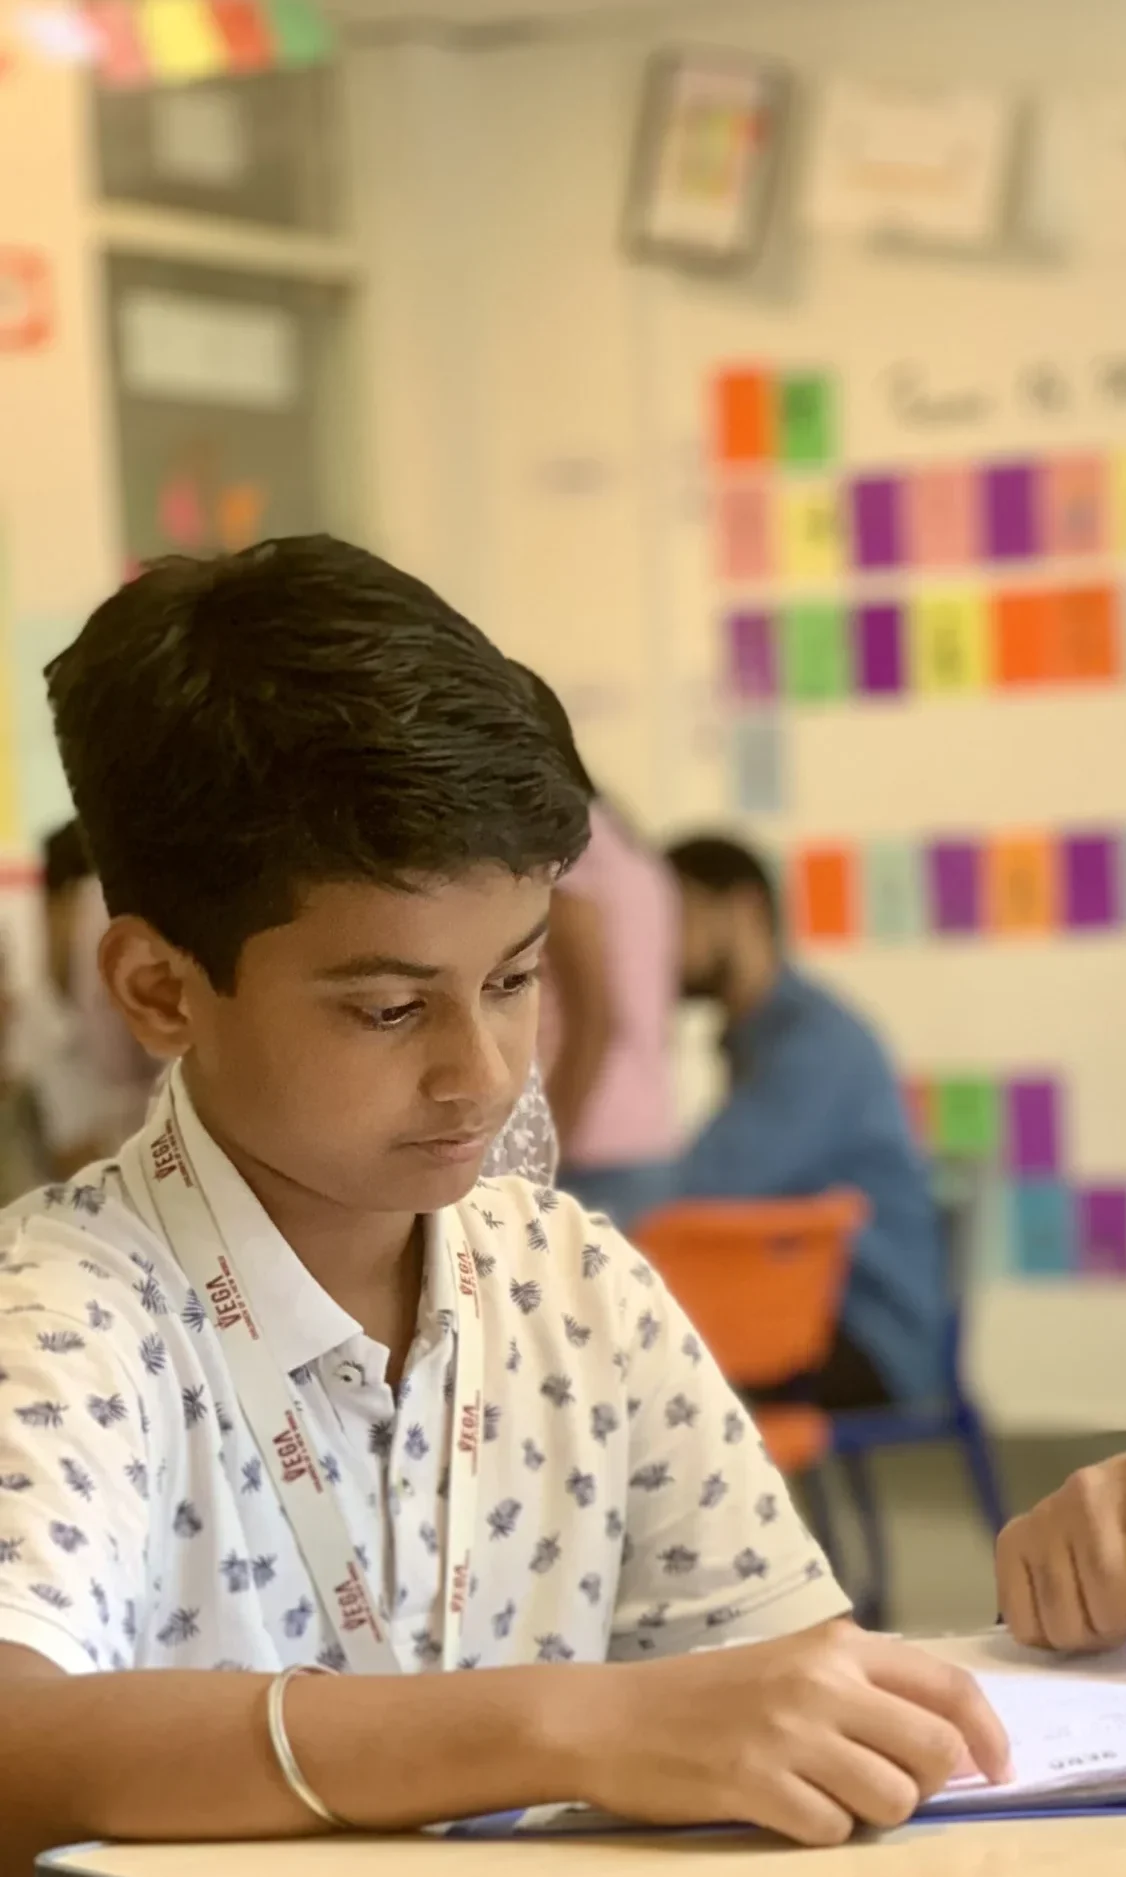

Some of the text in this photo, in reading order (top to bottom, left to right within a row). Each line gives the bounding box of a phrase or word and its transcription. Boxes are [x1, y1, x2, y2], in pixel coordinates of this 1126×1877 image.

[151, 1133, 177, 1182] VEGA
[457, 1252, 473, 1296] VEGA
[205, 1275, 241, 1330] VEGA
[273, 1430, 306, 1483] VEGA
[334, 1580, 366, 1631] VEGA
